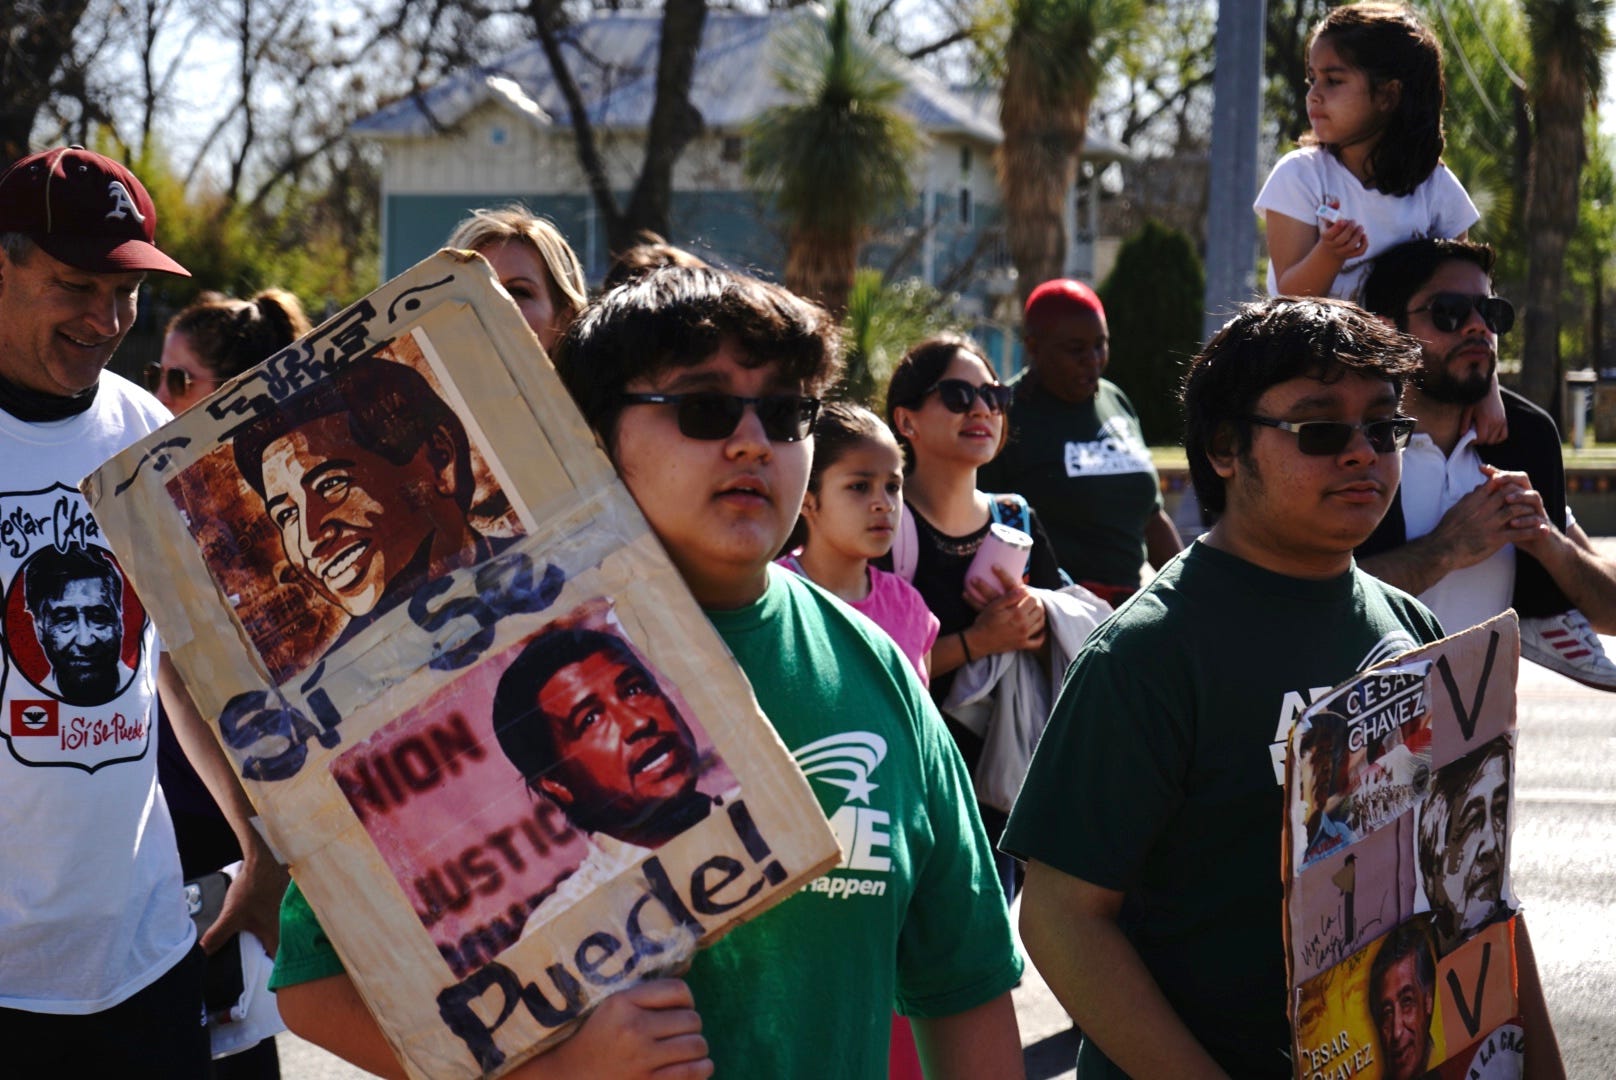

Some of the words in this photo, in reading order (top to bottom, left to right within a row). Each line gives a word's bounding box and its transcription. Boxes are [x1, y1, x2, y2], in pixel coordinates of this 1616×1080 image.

[106, 180, 145, 223] A
[0, 506, 51, 558] esar
[1348, 691, 1425, 752] CHAVEZ
[1437, 630, 1499, 741] V
[438, 799, 789, 1073] Puede!
[1447, 942, 1491, 1038] V
